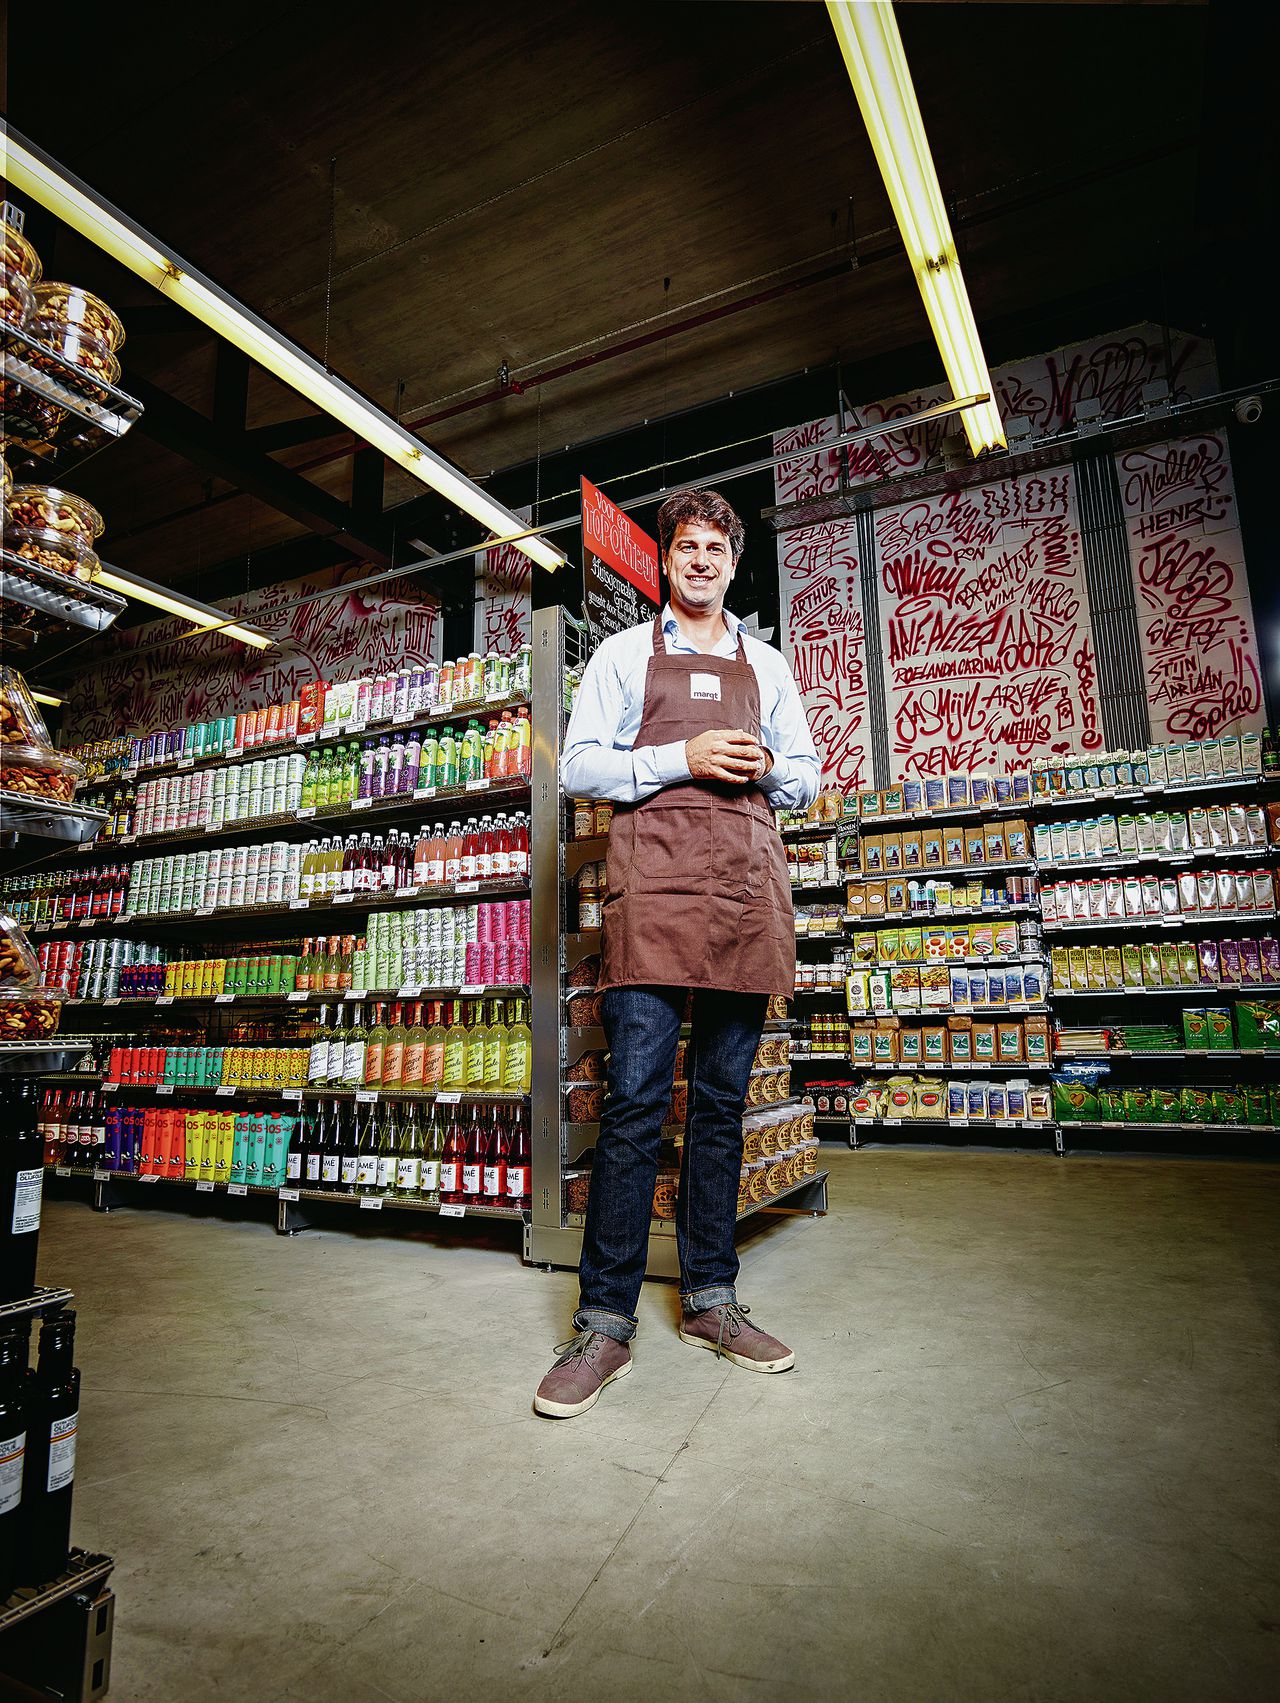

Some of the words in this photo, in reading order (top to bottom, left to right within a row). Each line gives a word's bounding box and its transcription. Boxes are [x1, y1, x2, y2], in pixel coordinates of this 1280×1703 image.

[595, 491, 616, 521] Voor
[616, 514, 631, 538] een
[953, 547, 985, 565] RON
[789, 577, 841, 627] ARTHUR
[1021, 578, 1080, 621] MARCO
[256, 665, 295, 692] TIM
[693, 691, 718, 700] marqt
[1167, 681, 1260, 743] Sophie
[905, 737, 987, 775] RENEE
